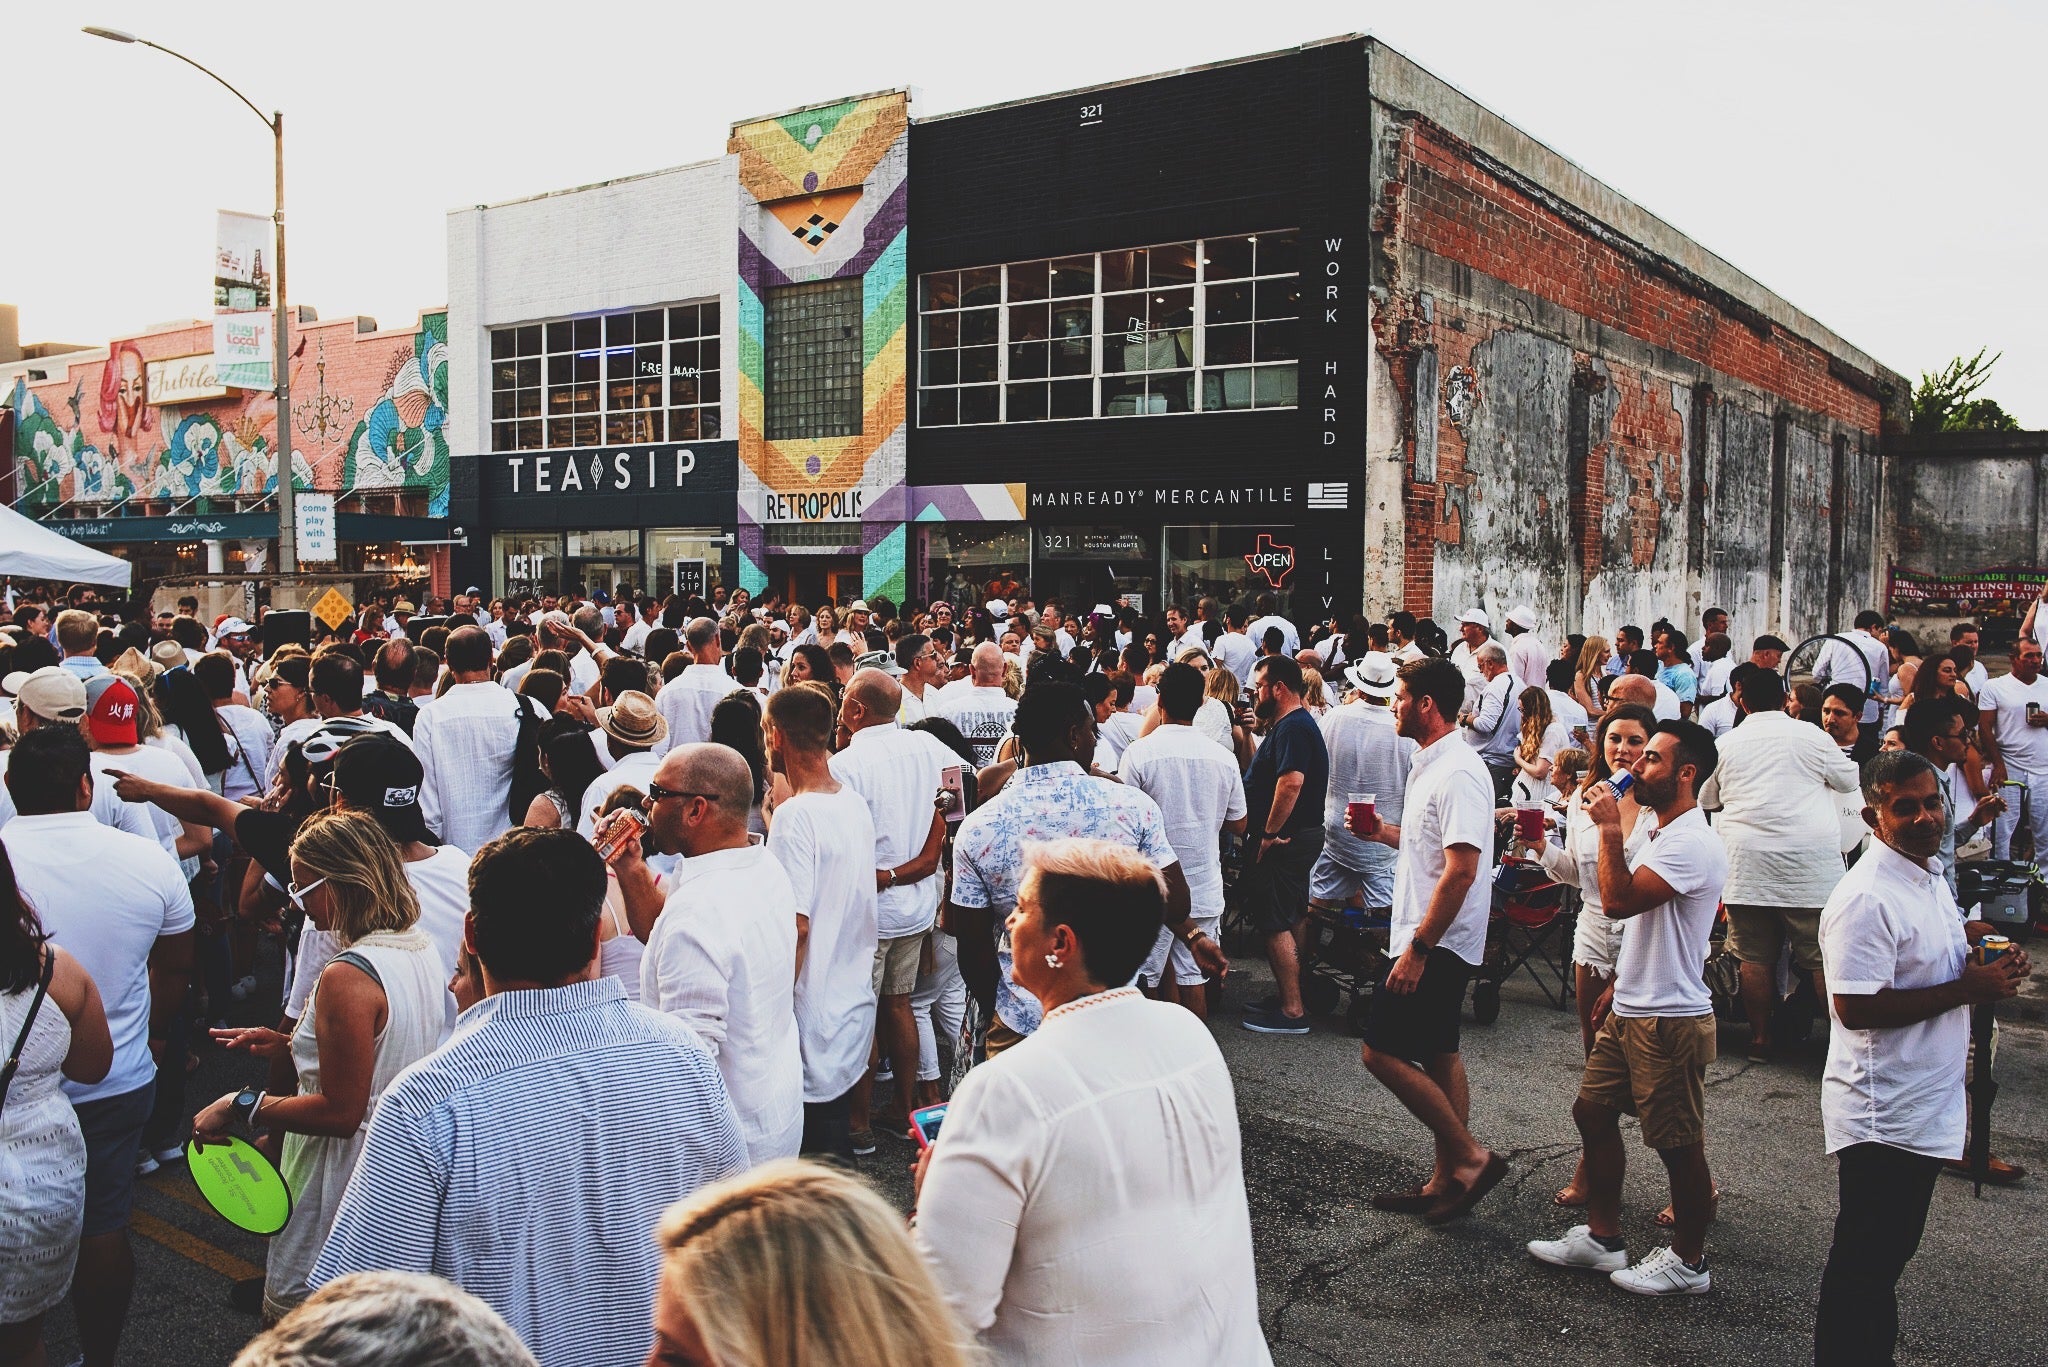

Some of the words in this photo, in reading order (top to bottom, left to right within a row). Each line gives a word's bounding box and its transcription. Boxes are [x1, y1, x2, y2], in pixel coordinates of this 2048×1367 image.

[1080, 103, 1102, 119] 321
[1325, 238, 1342, 323] WORK
[641, 361, 662, 375] FRE
[1324, 361, 1337, 445] HARD
[508, 455, 583, 493] TEA
[614, 449, 696, 491] SIP
[1155, 487, 1292, 504] MERCANTILE
[302, 504, 327, 513] come
[305, 515, 325, 527] play
[305, 528, 326, 538] with
[310, 541, 321, 549] us
[1044, 535, 1071, 548] 321
[509, 554, 528, 579] ICE
[531, 554, 544, 579] IT
[1253, 553, 1291, 568] OPEN
[680, 571, 700, 580] TEA
[1941, 573, 2007, 582] HOMEMADE
[680, 582, 700, 591] SIP
[1973, 582, 2013, 591] LUNCH
[1894, 588, 1939, 598] BRUNCH
[1950, 591, 1994, 599] BAKERY
[2005, 592, 2032, 600] PLAY
[215, 1156, 235, 1182] Center
